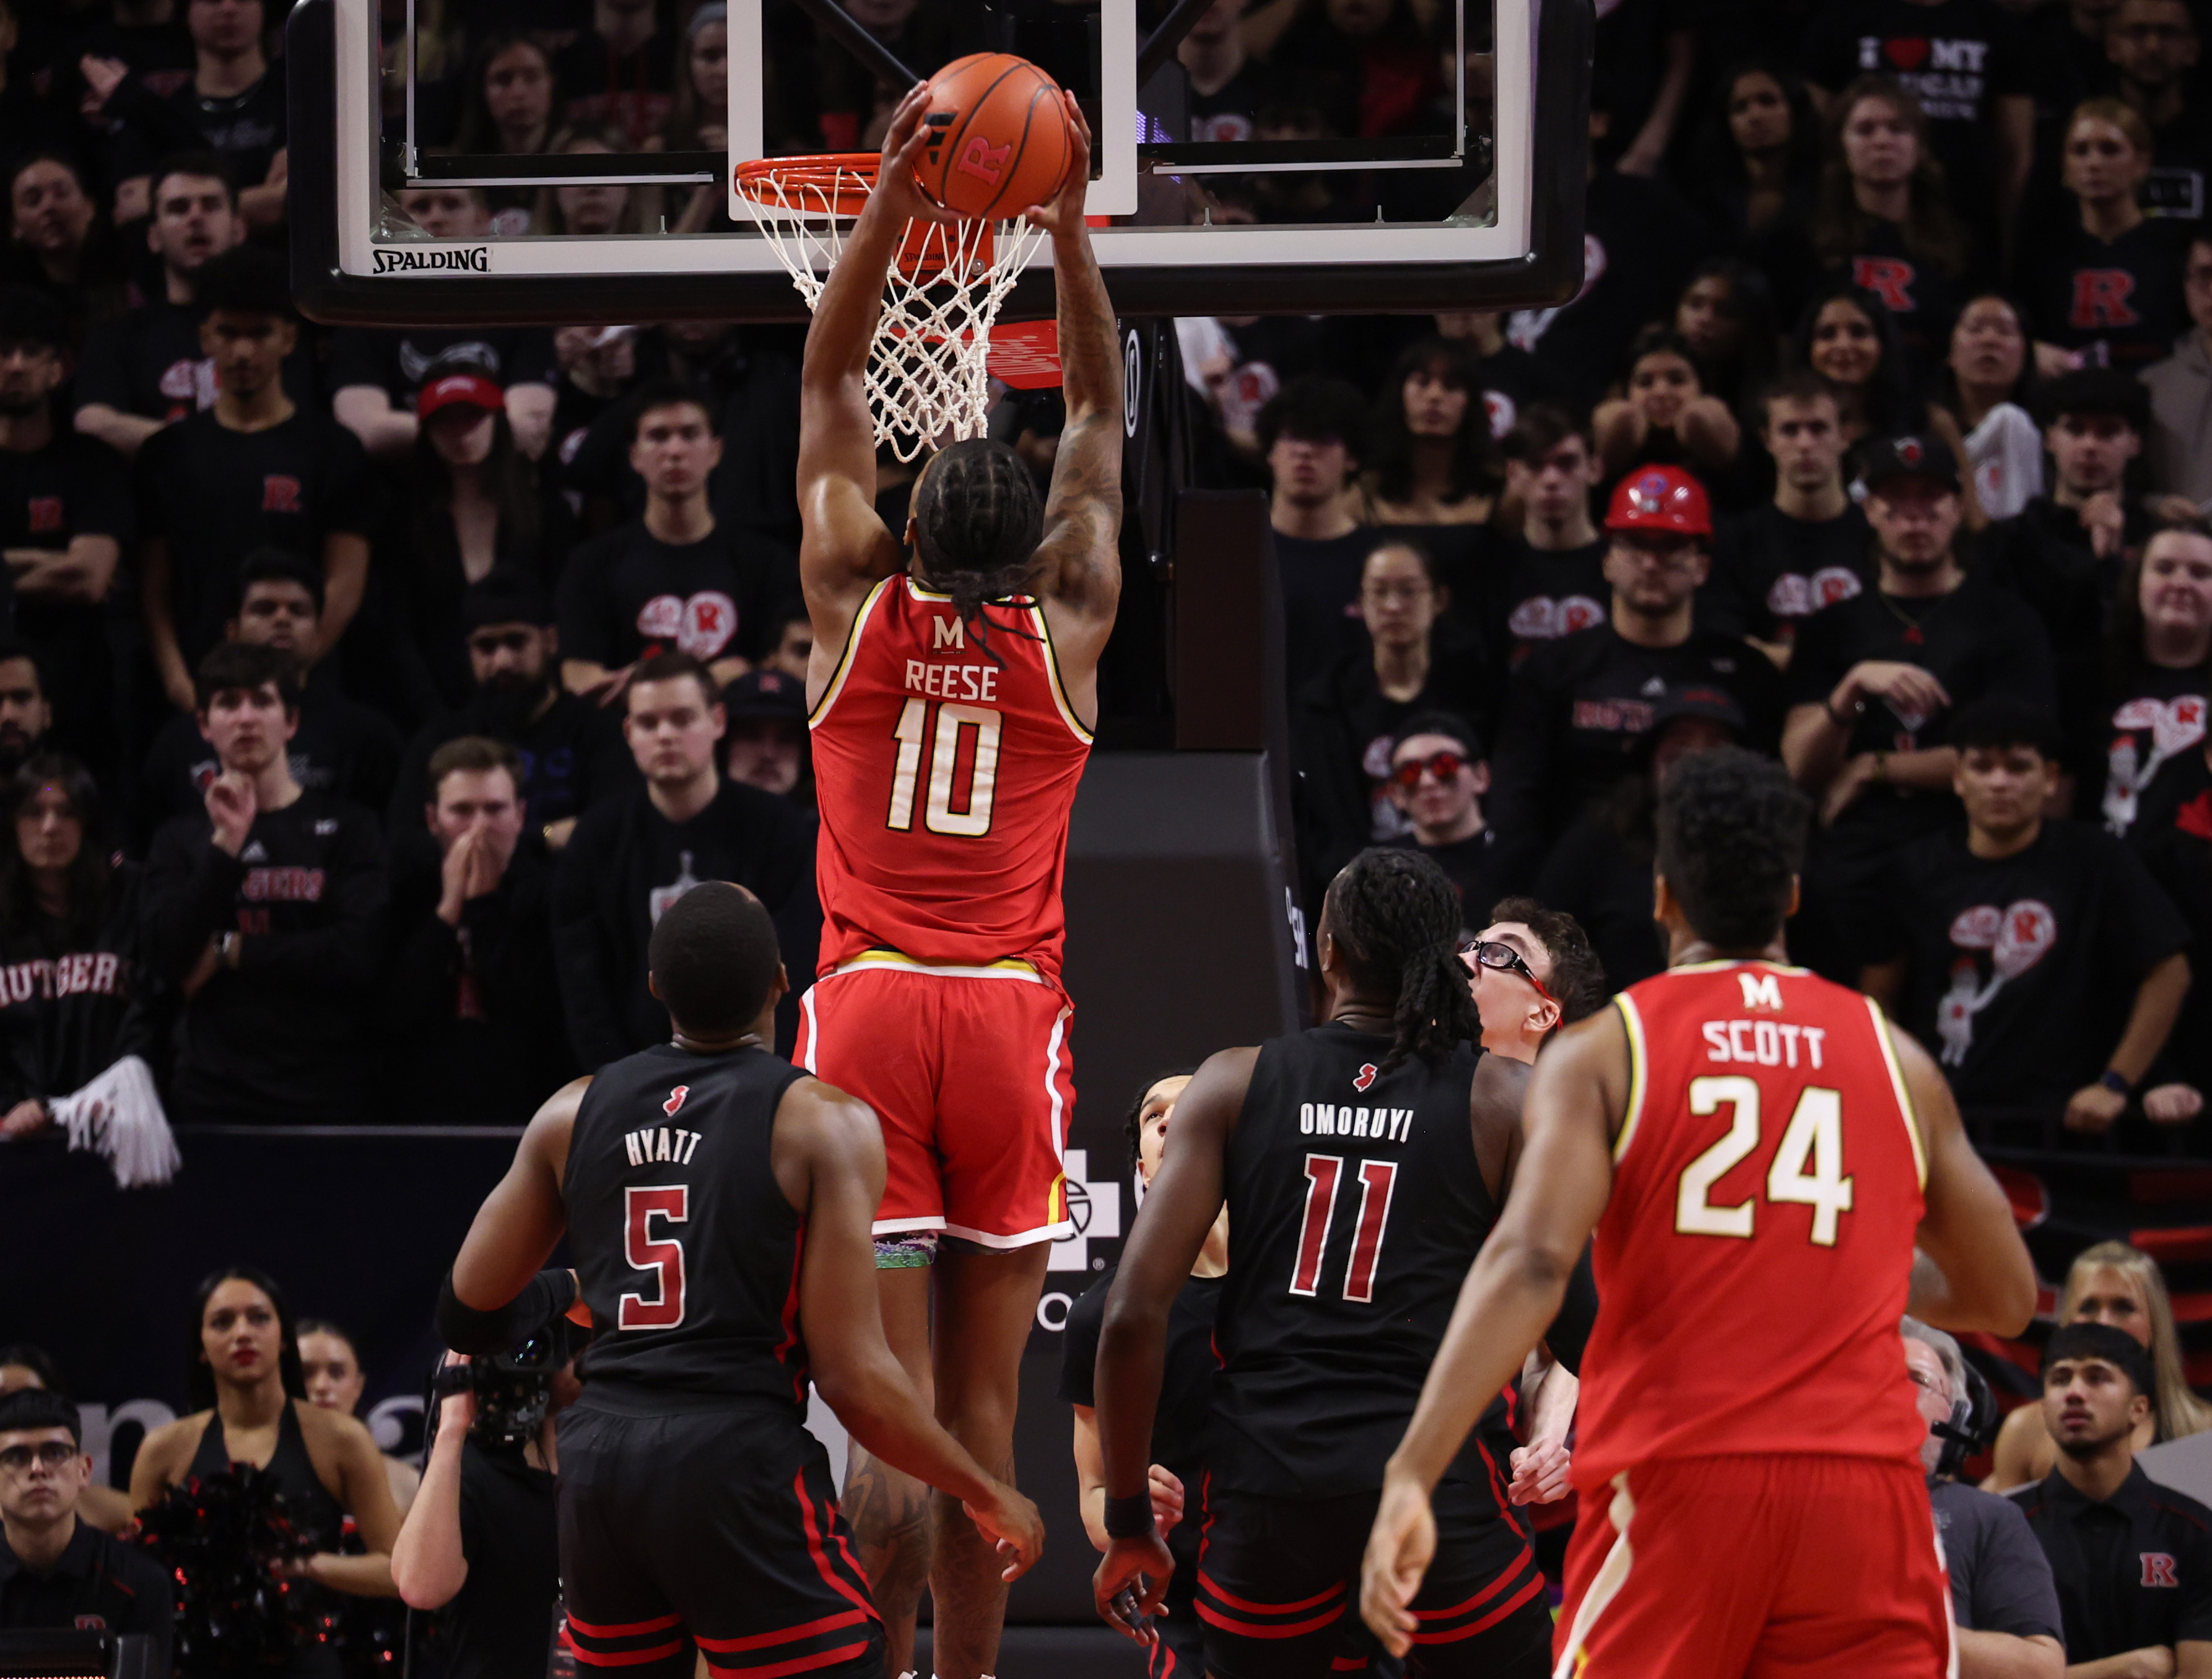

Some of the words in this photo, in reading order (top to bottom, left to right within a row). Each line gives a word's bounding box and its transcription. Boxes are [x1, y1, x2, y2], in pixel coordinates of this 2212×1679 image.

[1930, 37, 1989, 72] MY
[957, 136, 1011, 185] R
[373, 247, 487, 274] SPALDING
[1853, 256, 1918, 312] R
[2069, 267, 2140, 328] R
[263, 474, 302, 512] R
[932, 615, 965, 649] M
[905, 659, 999, 702] REESE
[887, 697, 1004, 838] 10
[0, 951, 123, 1008] UTGER
[1737, 972, 1784, 1010] M
[1702, 1020, 1825, 1069] SCOTT
[1300, 1102, 1414, 1143] OMORUYI
[625, 1127, 702, 1167] HYATT
[1675, 1075, 1853, 1247] 24
[1289, 1153, 1398, 1303] 11
[619, 1184, 689, 1330] 5
[2139, 1552, 2179, 1587] R
